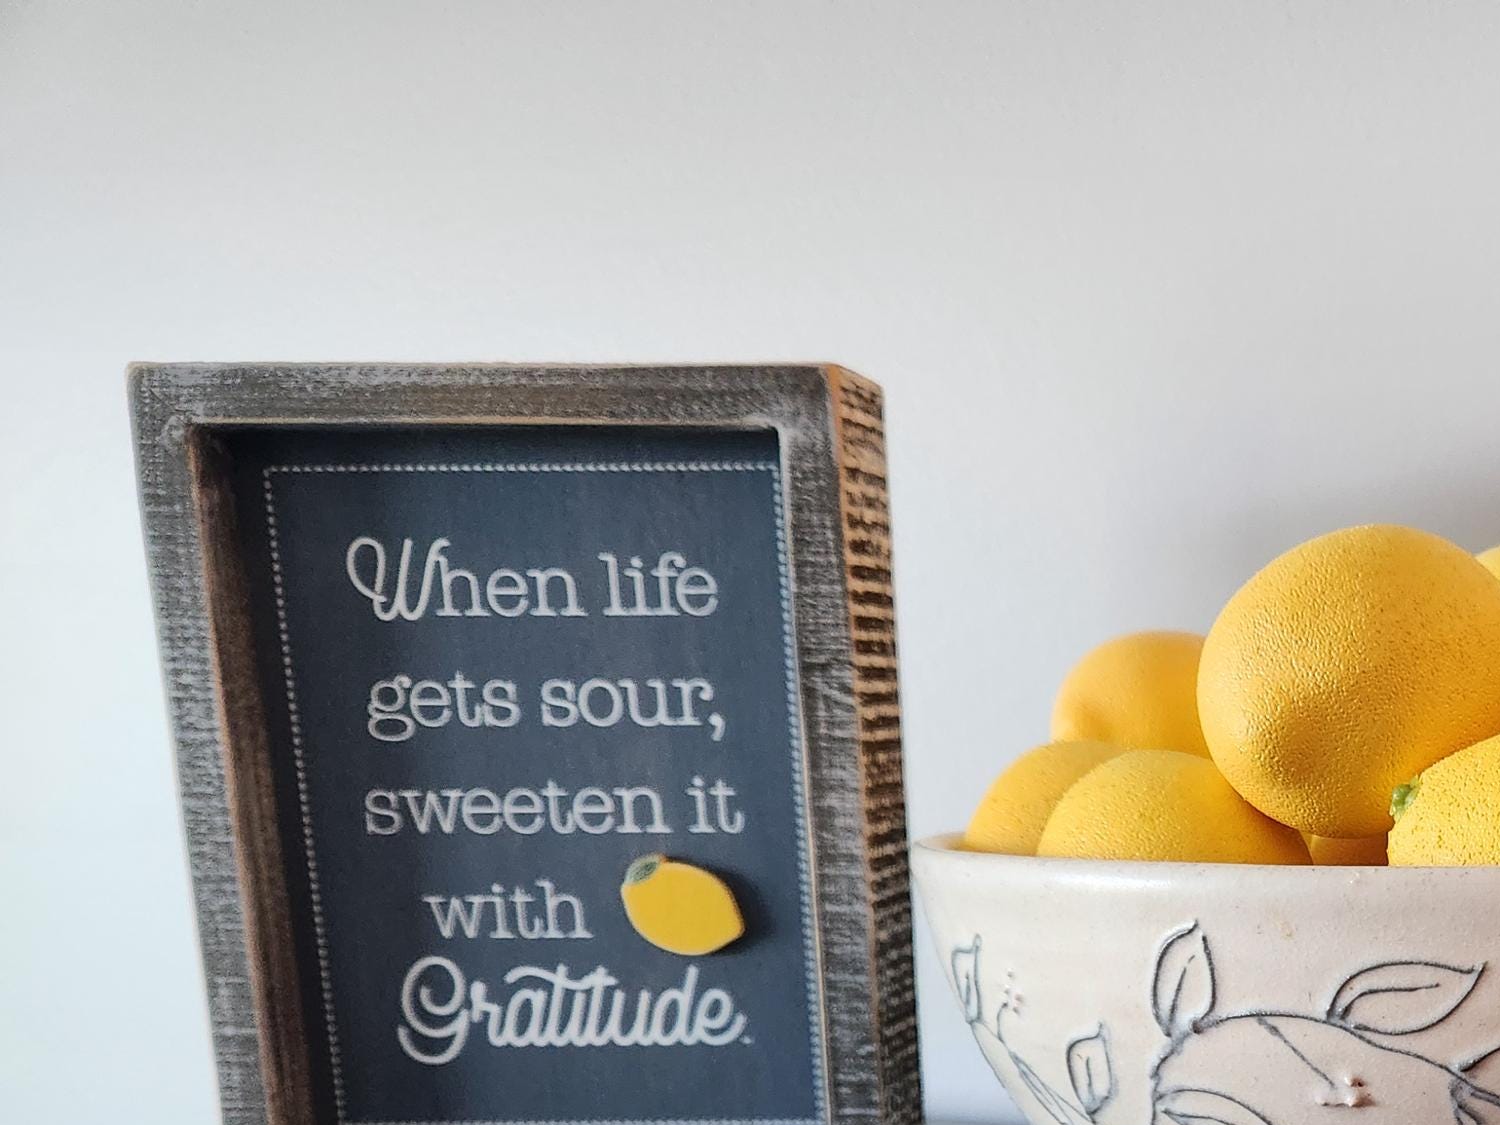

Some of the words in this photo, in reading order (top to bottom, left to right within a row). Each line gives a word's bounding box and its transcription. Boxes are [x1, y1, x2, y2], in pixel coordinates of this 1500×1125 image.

[346, 536, 590, 622] When
[598, 551, 719, 618] life
[367, 669, 522, 742] gets
[540, 677, 727, 742] sour,
[364, 780, 673, 836] sweeten
[686, 775, 746, 835] it
[422, 878, 594, 940] with
